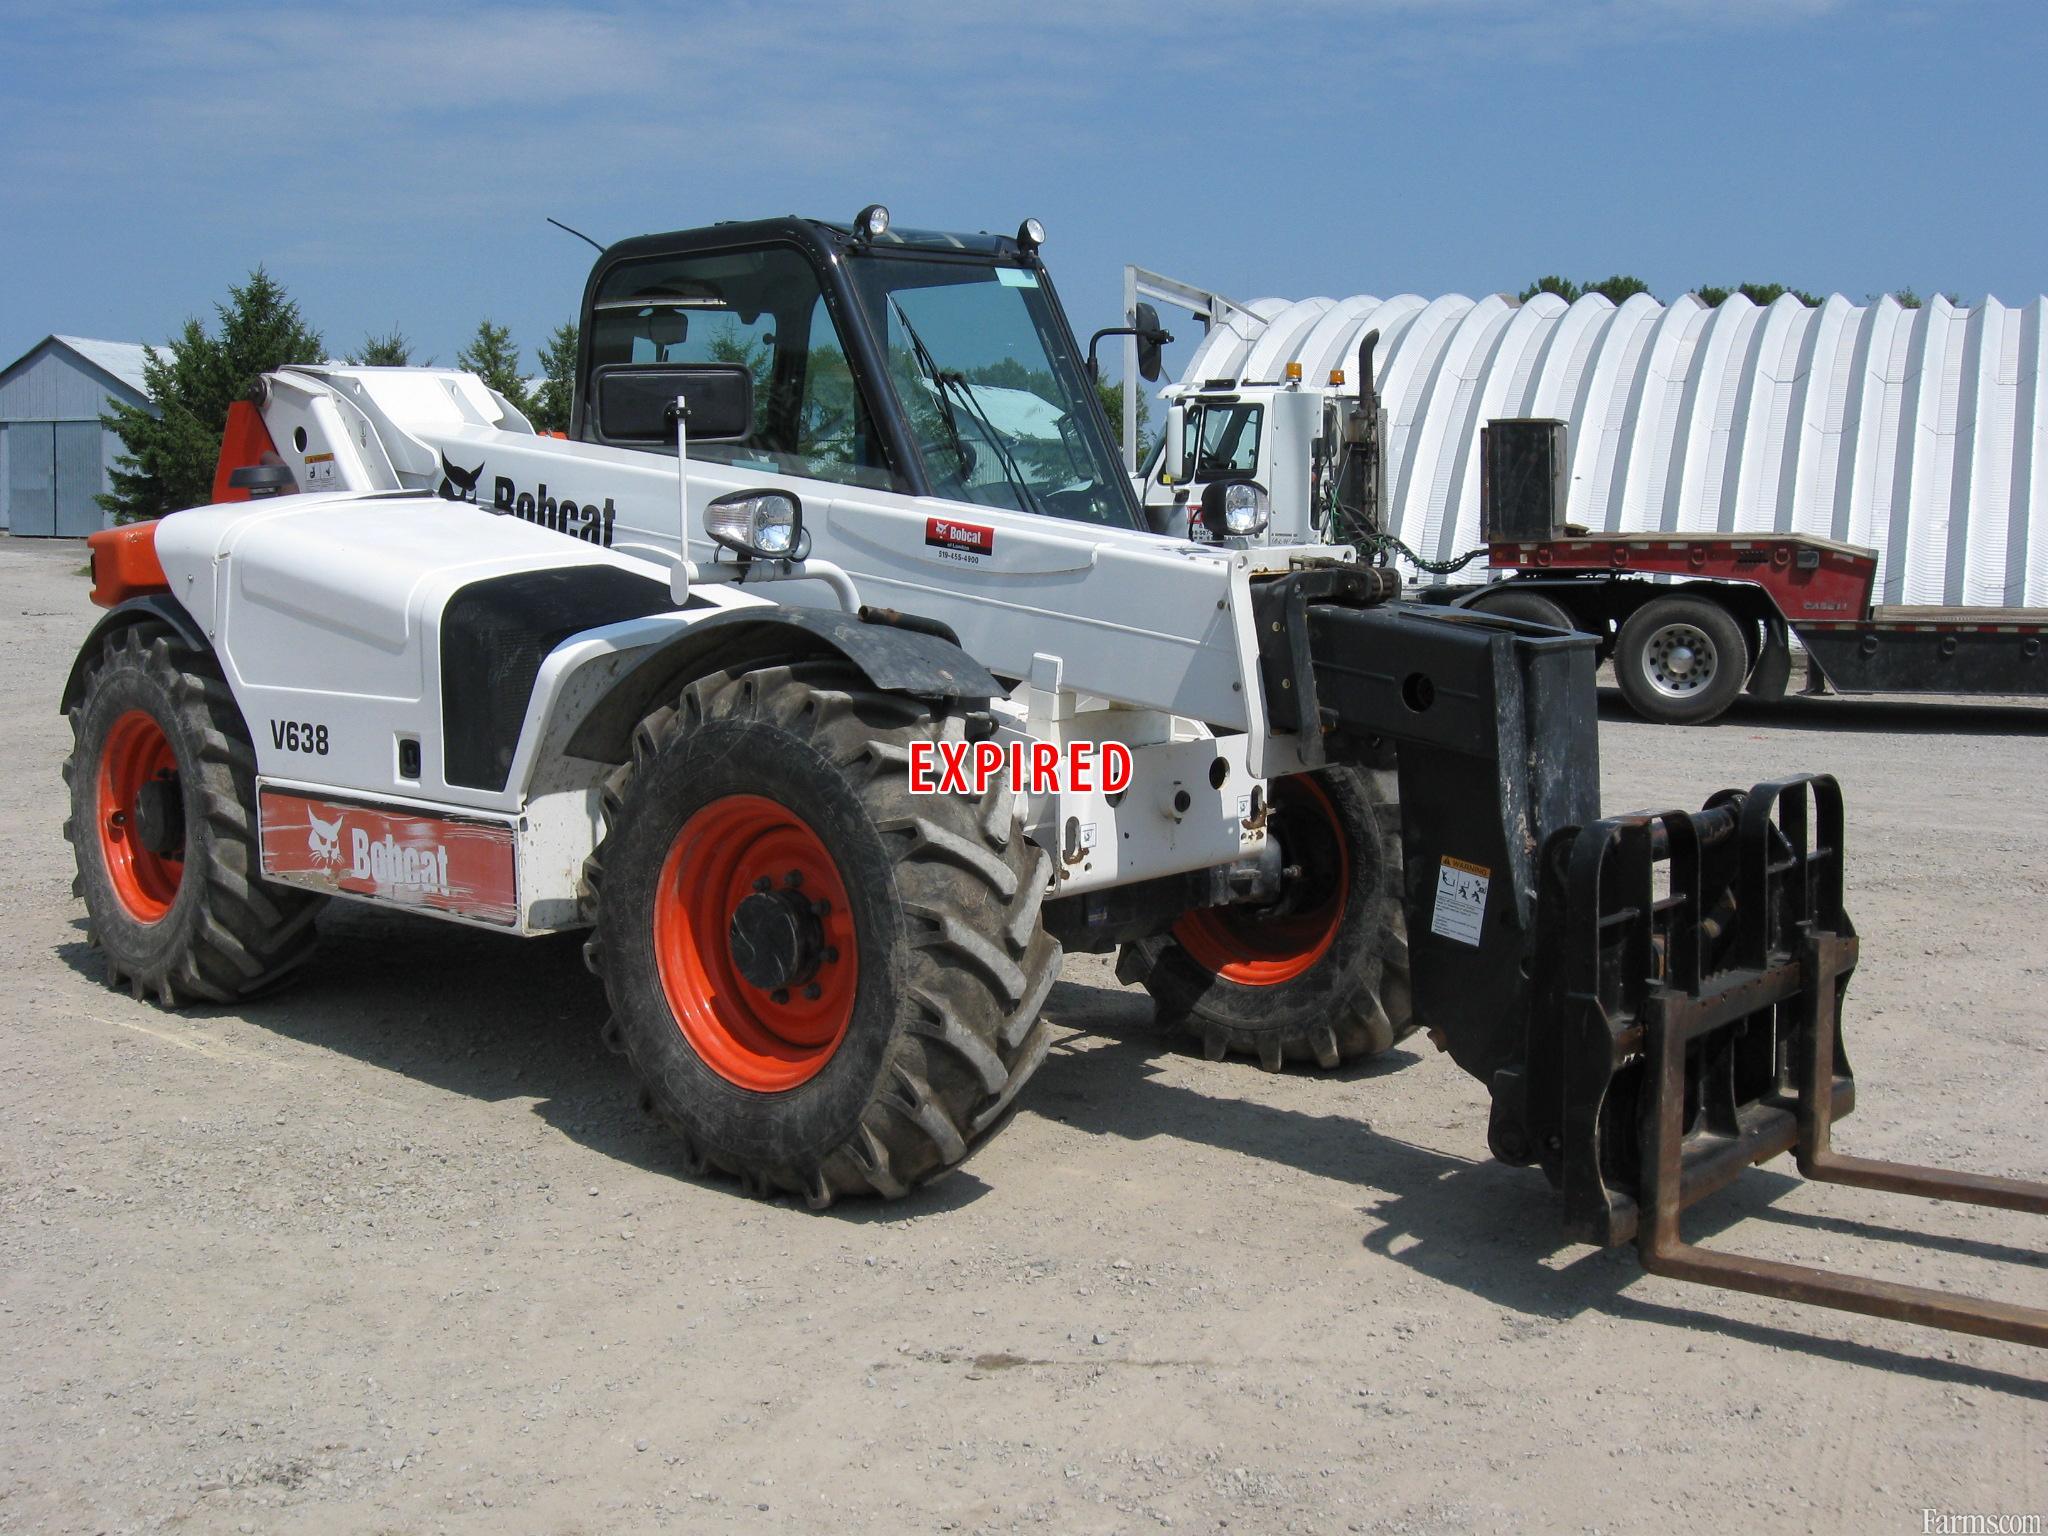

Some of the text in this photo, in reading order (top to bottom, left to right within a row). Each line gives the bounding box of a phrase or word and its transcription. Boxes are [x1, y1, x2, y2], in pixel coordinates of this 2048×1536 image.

[950, 526, 981, 545] Bobcat
[271, 719, 329, 755] V638
[351, 828, 450, 896] Bobcat
